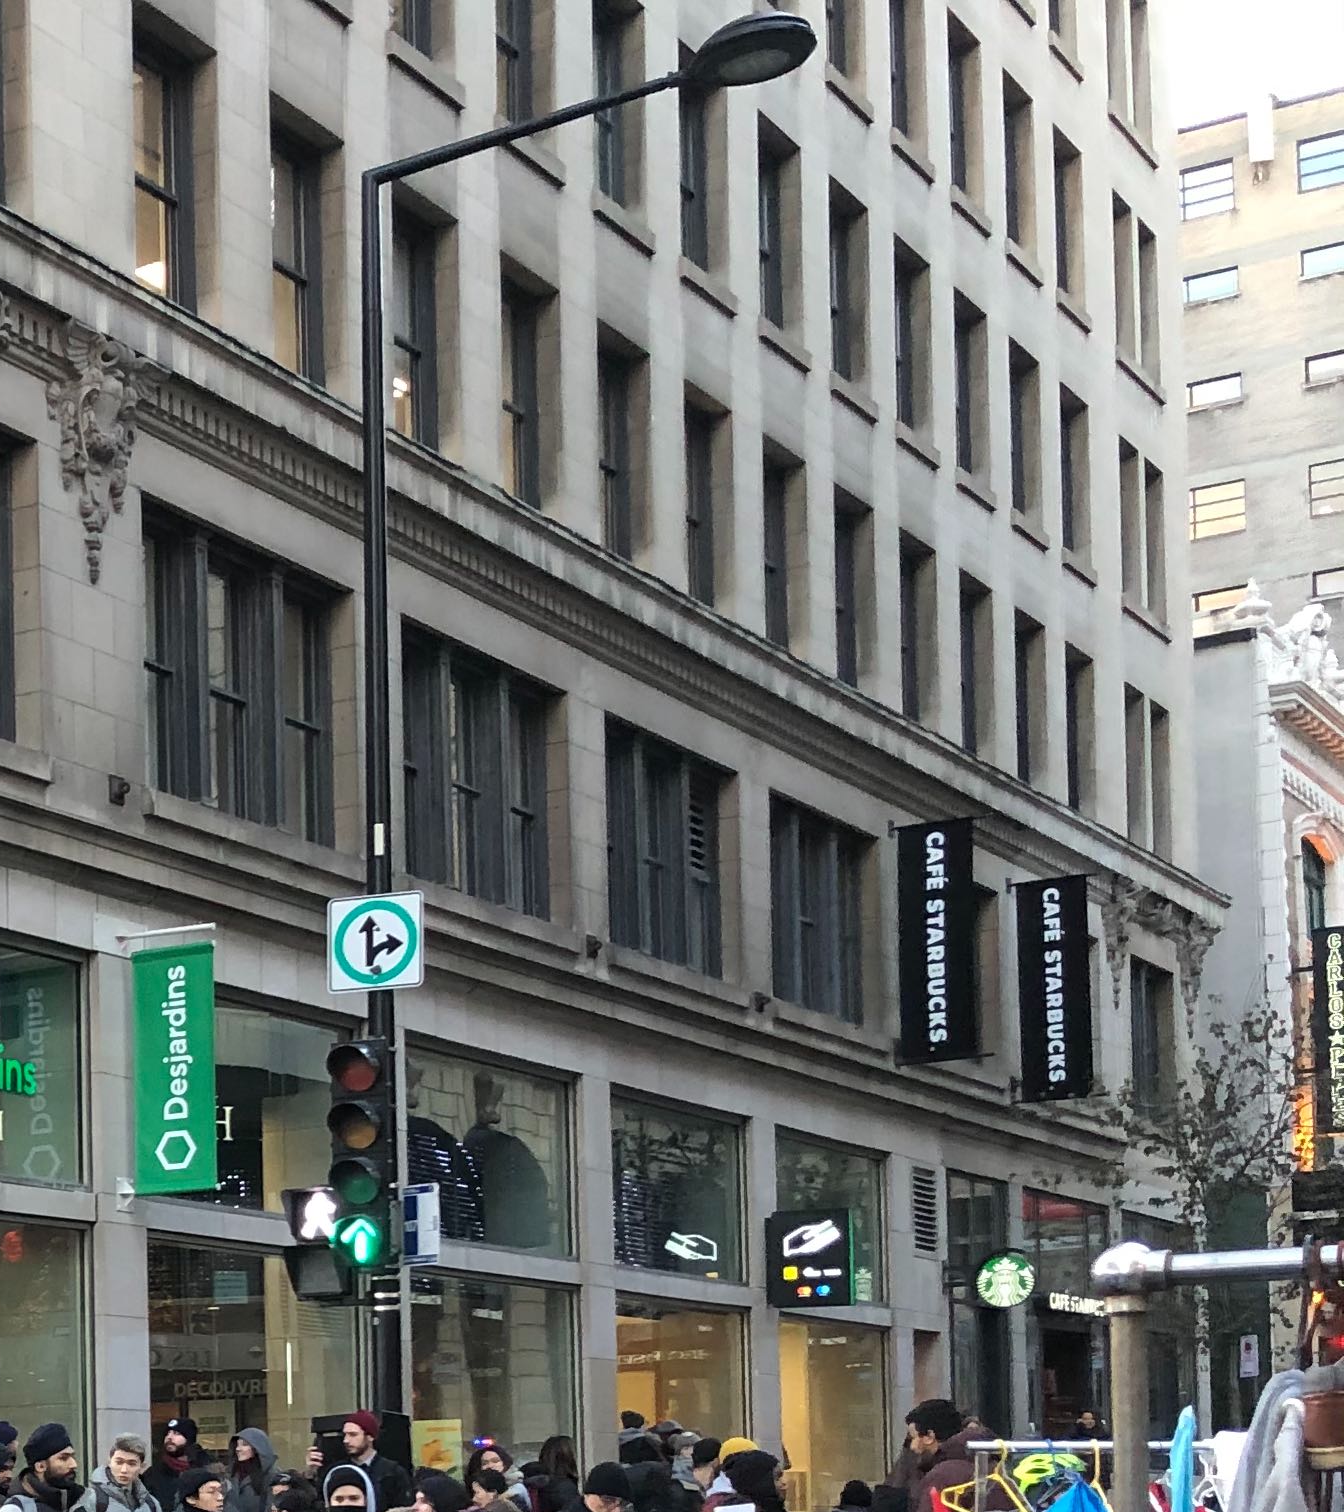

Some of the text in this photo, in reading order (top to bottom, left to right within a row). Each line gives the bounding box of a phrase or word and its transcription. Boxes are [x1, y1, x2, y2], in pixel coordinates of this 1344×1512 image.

[925, 831, 949, 1045] CAFÉ STARBUCKS
[1042, 887, 1066, 1084] CAFÉ STARBUCKS
[1326, 932, 1343, 1029] CARLOS
[161, 964, 193, 1121] Desjardins
